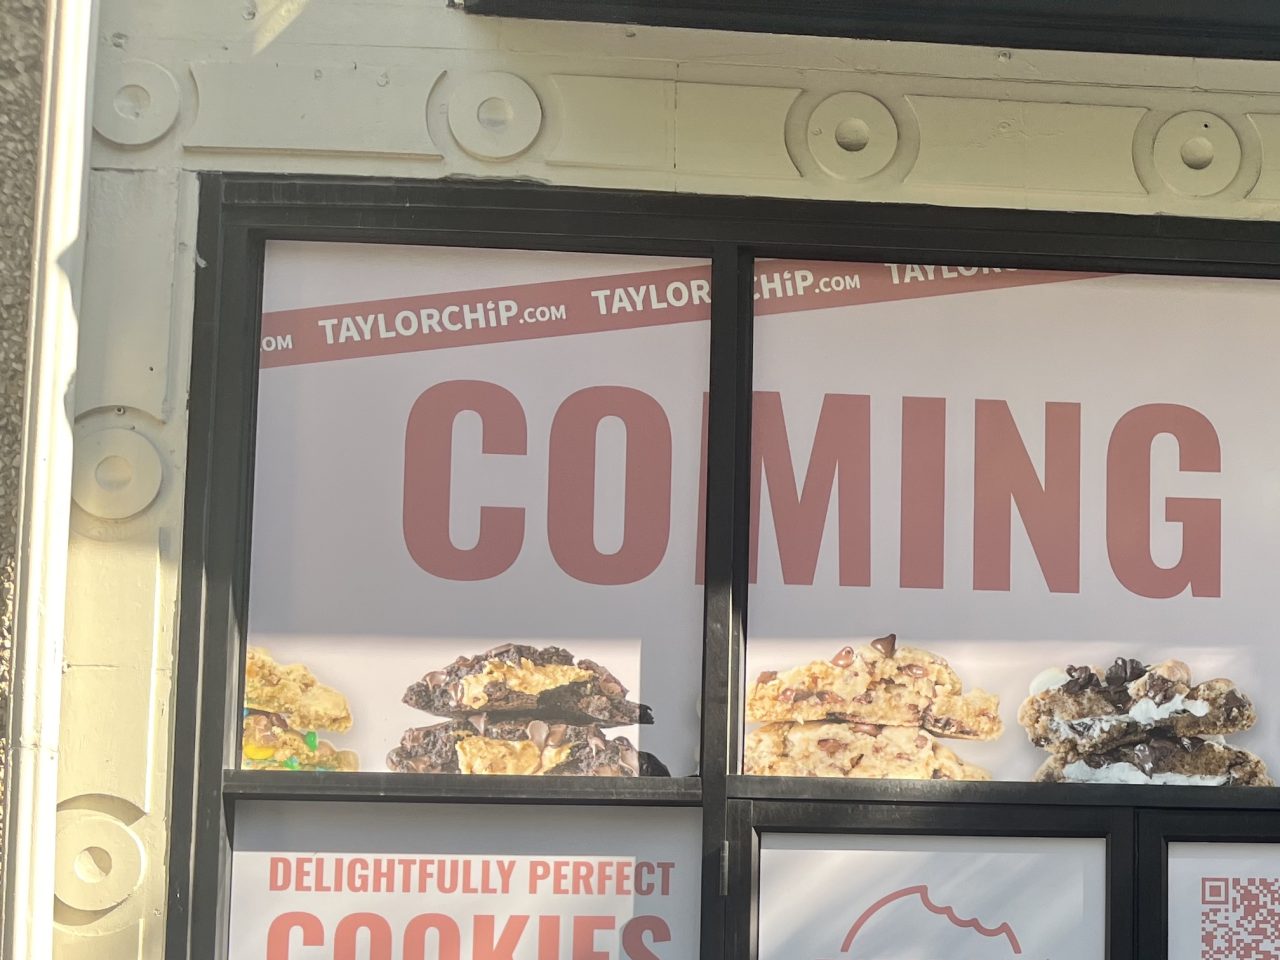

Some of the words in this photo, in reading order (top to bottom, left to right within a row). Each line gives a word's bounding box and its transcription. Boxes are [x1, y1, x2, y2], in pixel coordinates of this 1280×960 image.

[402, 379, 1222, 599] COMING
[268, 857, 516, 895] DELIGHTFULLY
[528, 860, 675, 896] PERFECT
